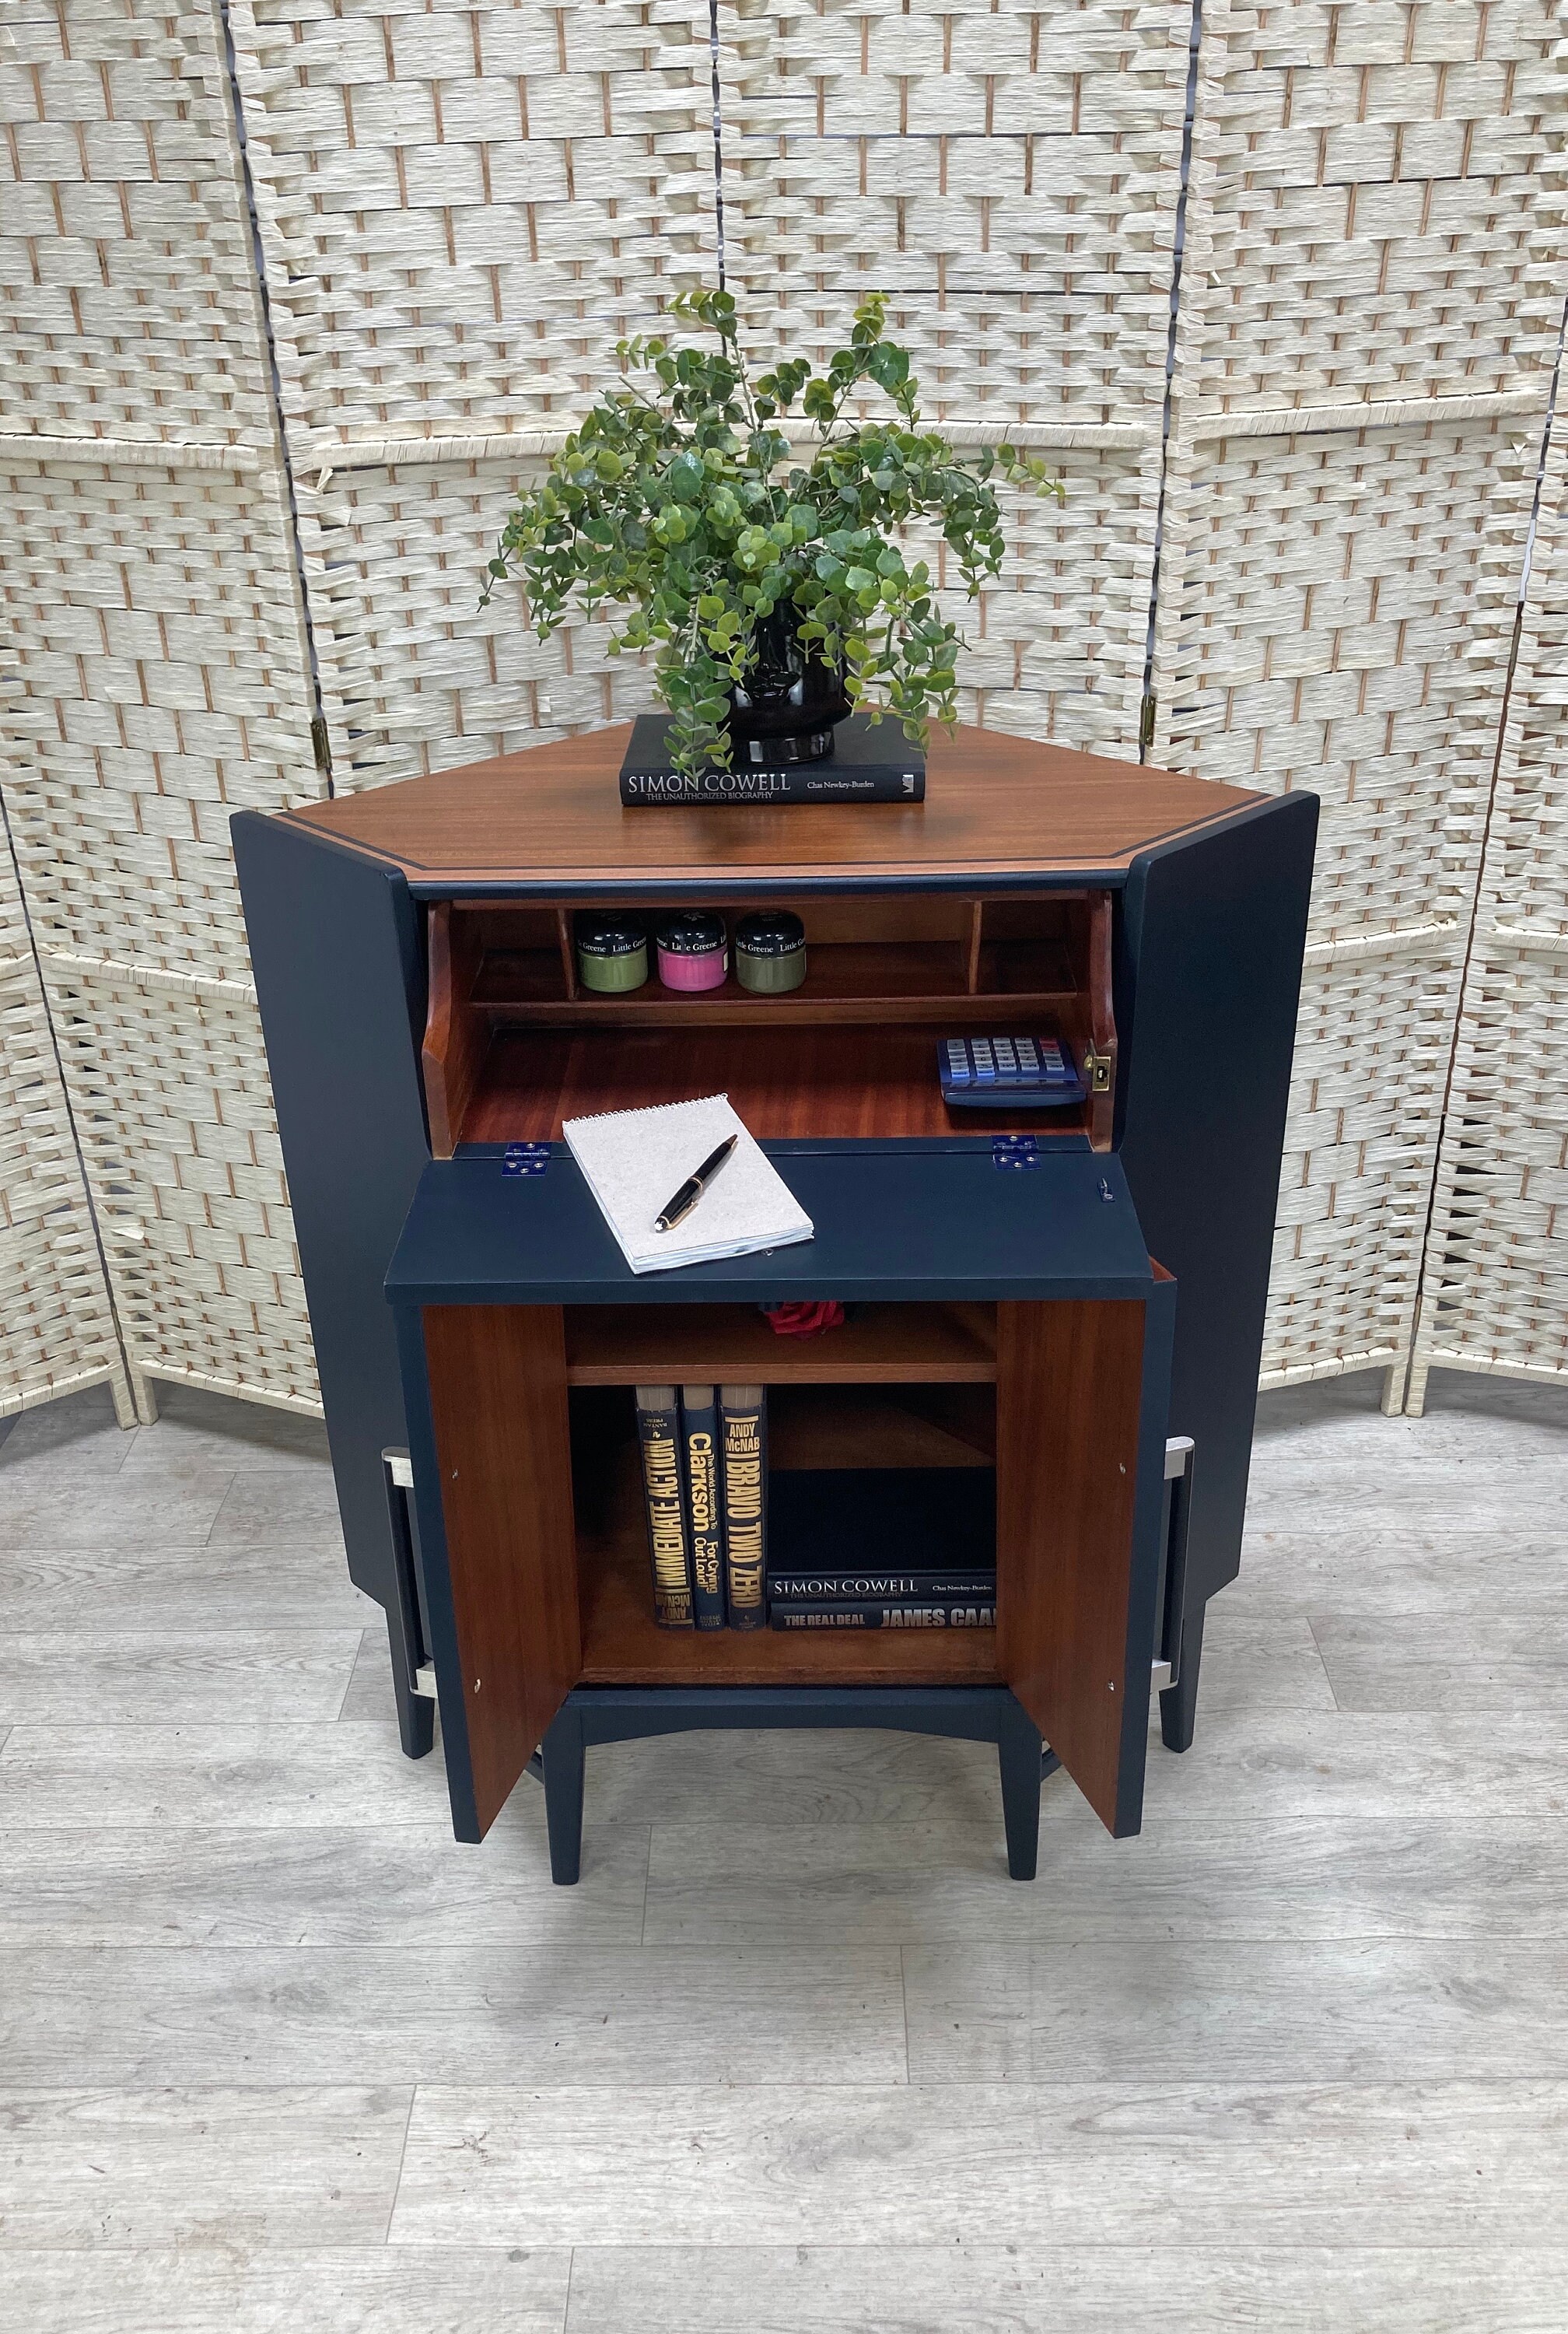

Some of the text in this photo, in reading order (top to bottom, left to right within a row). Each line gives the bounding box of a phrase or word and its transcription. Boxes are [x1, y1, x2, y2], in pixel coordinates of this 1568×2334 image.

[628, 773, 791, 793] SIMON COWELL
[663, 792, 726, 801] UNAUTHORIZED
[727, 790, 773, 799] BIOGRAPHY
[583, 941, 607, 953] Greene
[612, 943, 632, 952] Little
[692, 941, 718, 951] Greene
[747, 943, 774, 953] Greene
[780, 941, 797, 952] Little
[729, 1422, 755, 1438] ANDY
[725, 1437, 760, 1453] McNAB
[688, 1432, 712, 1533] Clarkson
[707, 1467, 716, 1487] World
[726, 1460, 762, 1519] BRAVO
[643, 1438, 687, 1586] IMMEDIATE ACTION
[707, 1488, 717, 1521] According
[709, 1521, 717, 1530] To
[728, 1521, 762, 1564] TWO
[694, 1537, 708, 1589] Out Loud!
[705, 1540, 719, 1594] For Crying
[729, 1565, 762, 1609] ZERO
[775, 1579, 919, 1594] SIMON COWELL
[784, 1614, 866, 1626] THE REAL DEAL
[880, 1607, 996, 1628] JAMES CAA
